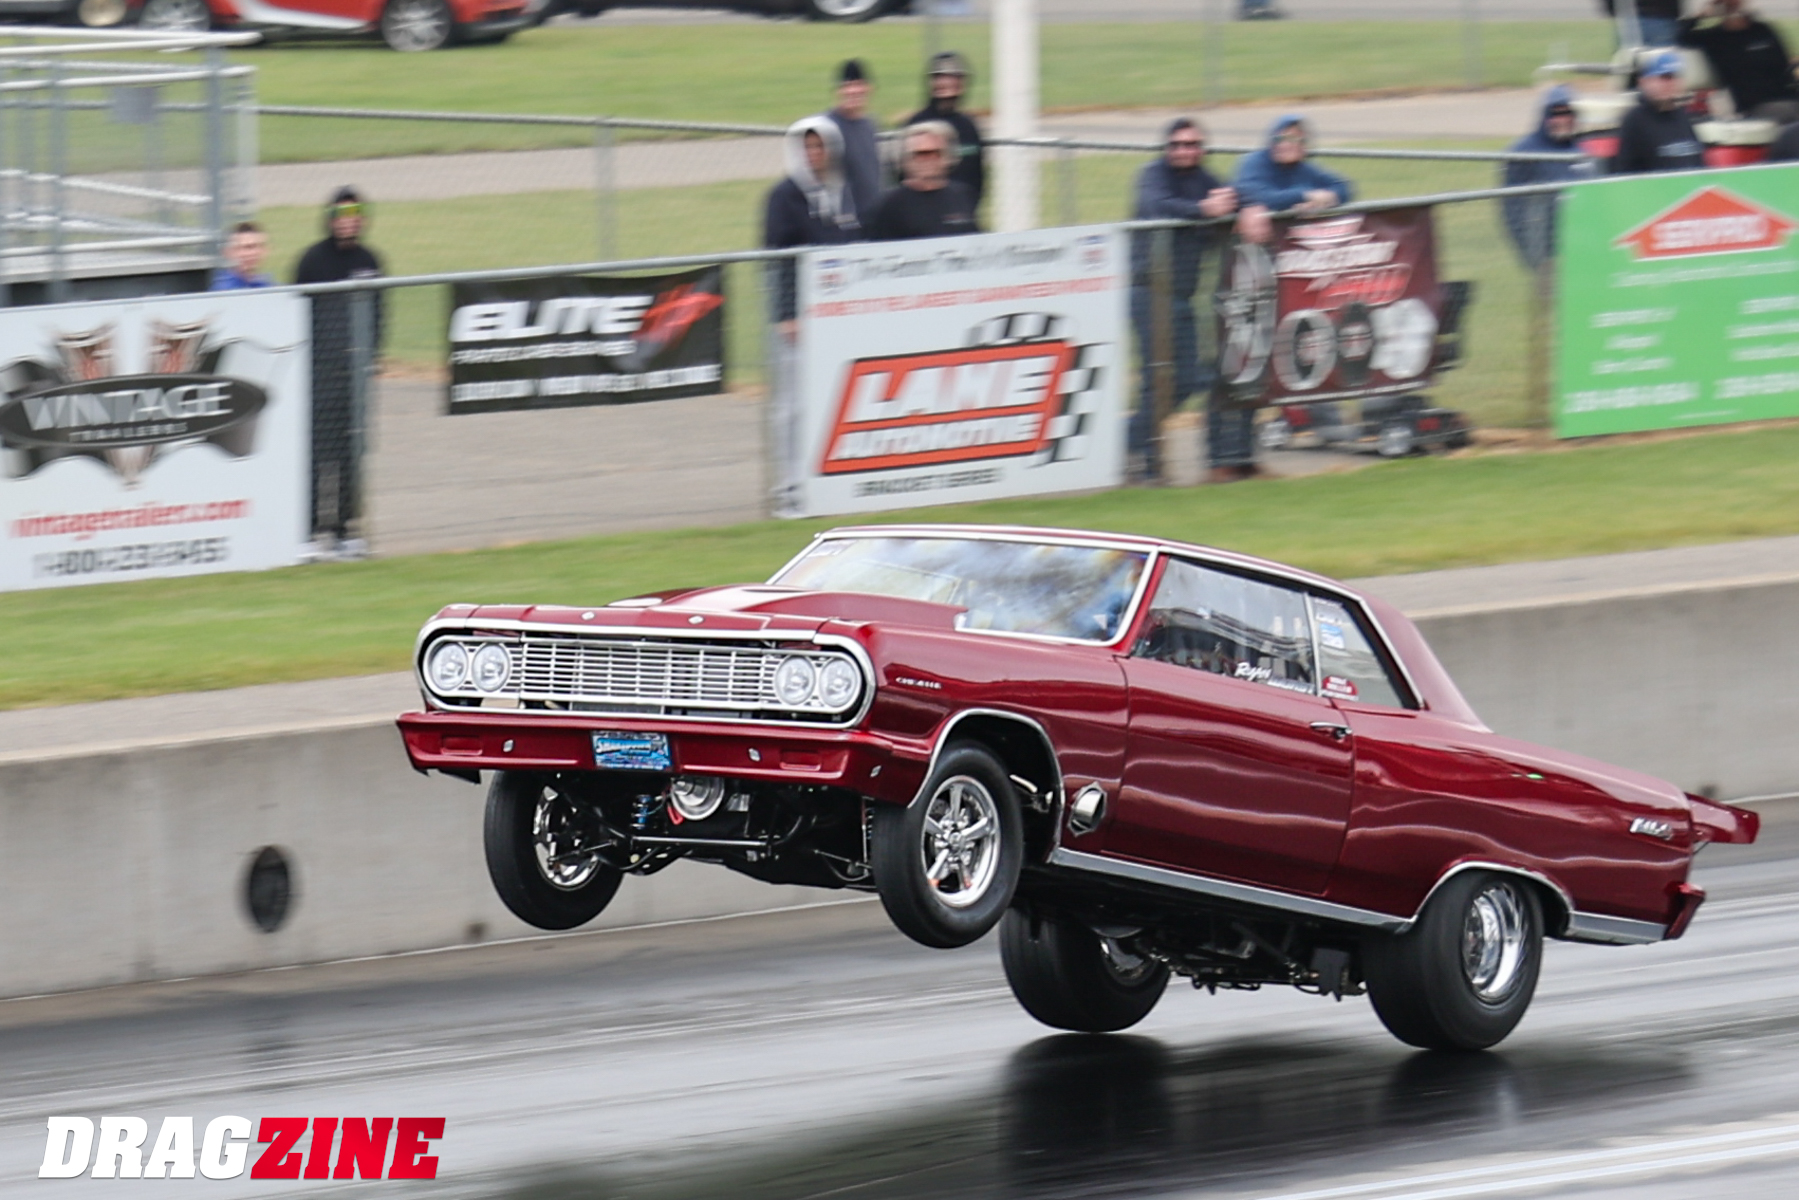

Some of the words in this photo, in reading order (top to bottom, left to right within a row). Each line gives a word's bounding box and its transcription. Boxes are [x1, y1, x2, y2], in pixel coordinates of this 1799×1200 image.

[450, 295, 653, 342] ELITE
[21, 381, 234, 431] VINTAGE
[842, 355, 1060, 424] LANE
